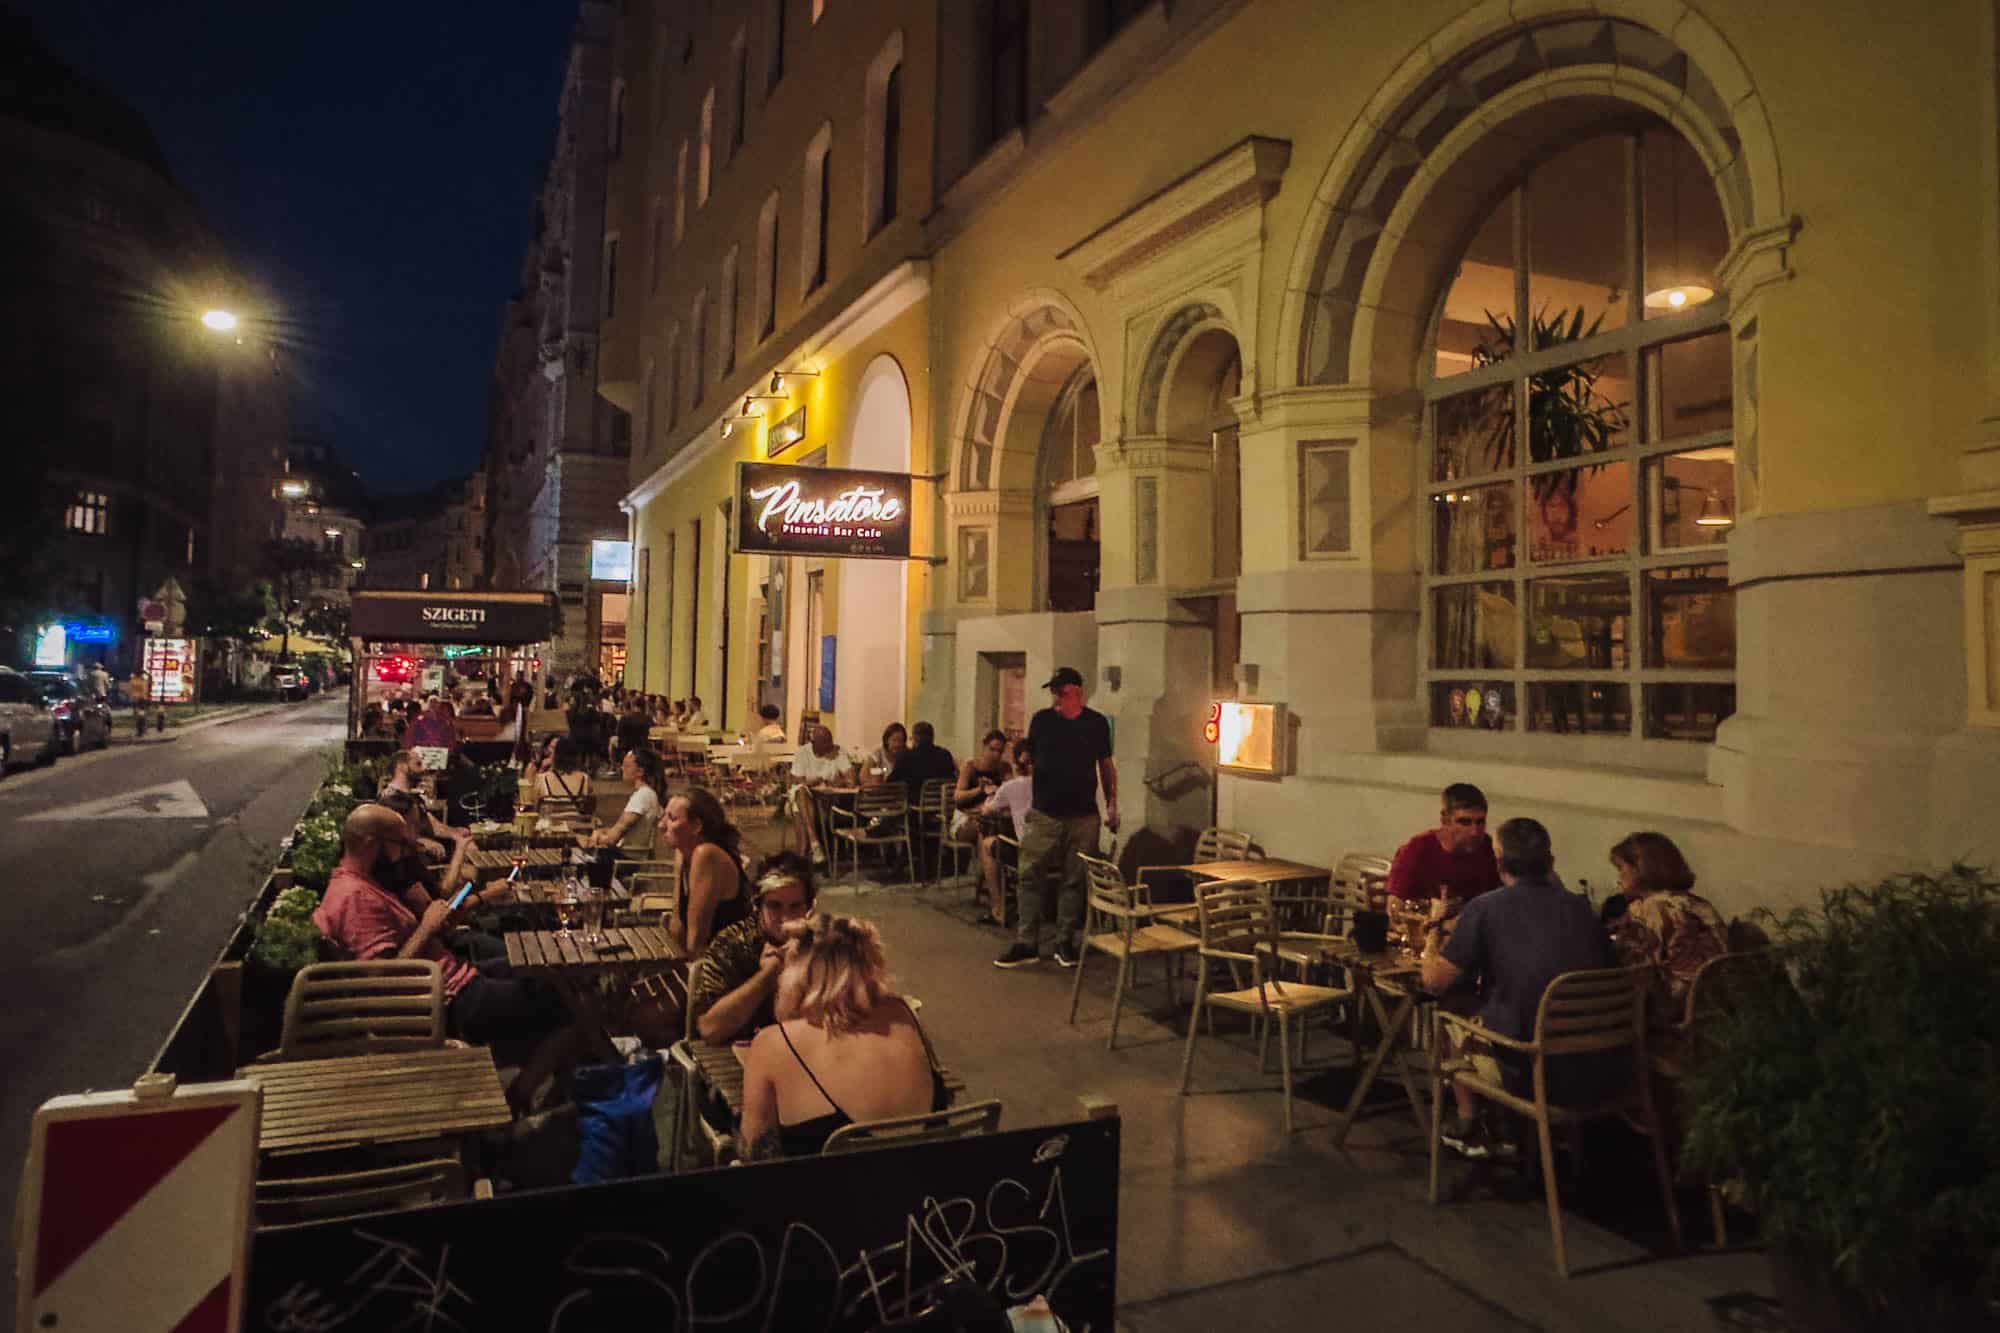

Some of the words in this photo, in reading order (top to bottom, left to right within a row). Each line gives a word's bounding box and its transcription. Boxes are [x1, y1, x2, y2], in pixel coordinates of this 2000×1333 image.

[750, 480, 901, 533] Pinsatore
[833, 526, 853, 537] Bar
[422, 607, 486, 622] SZIGETI
